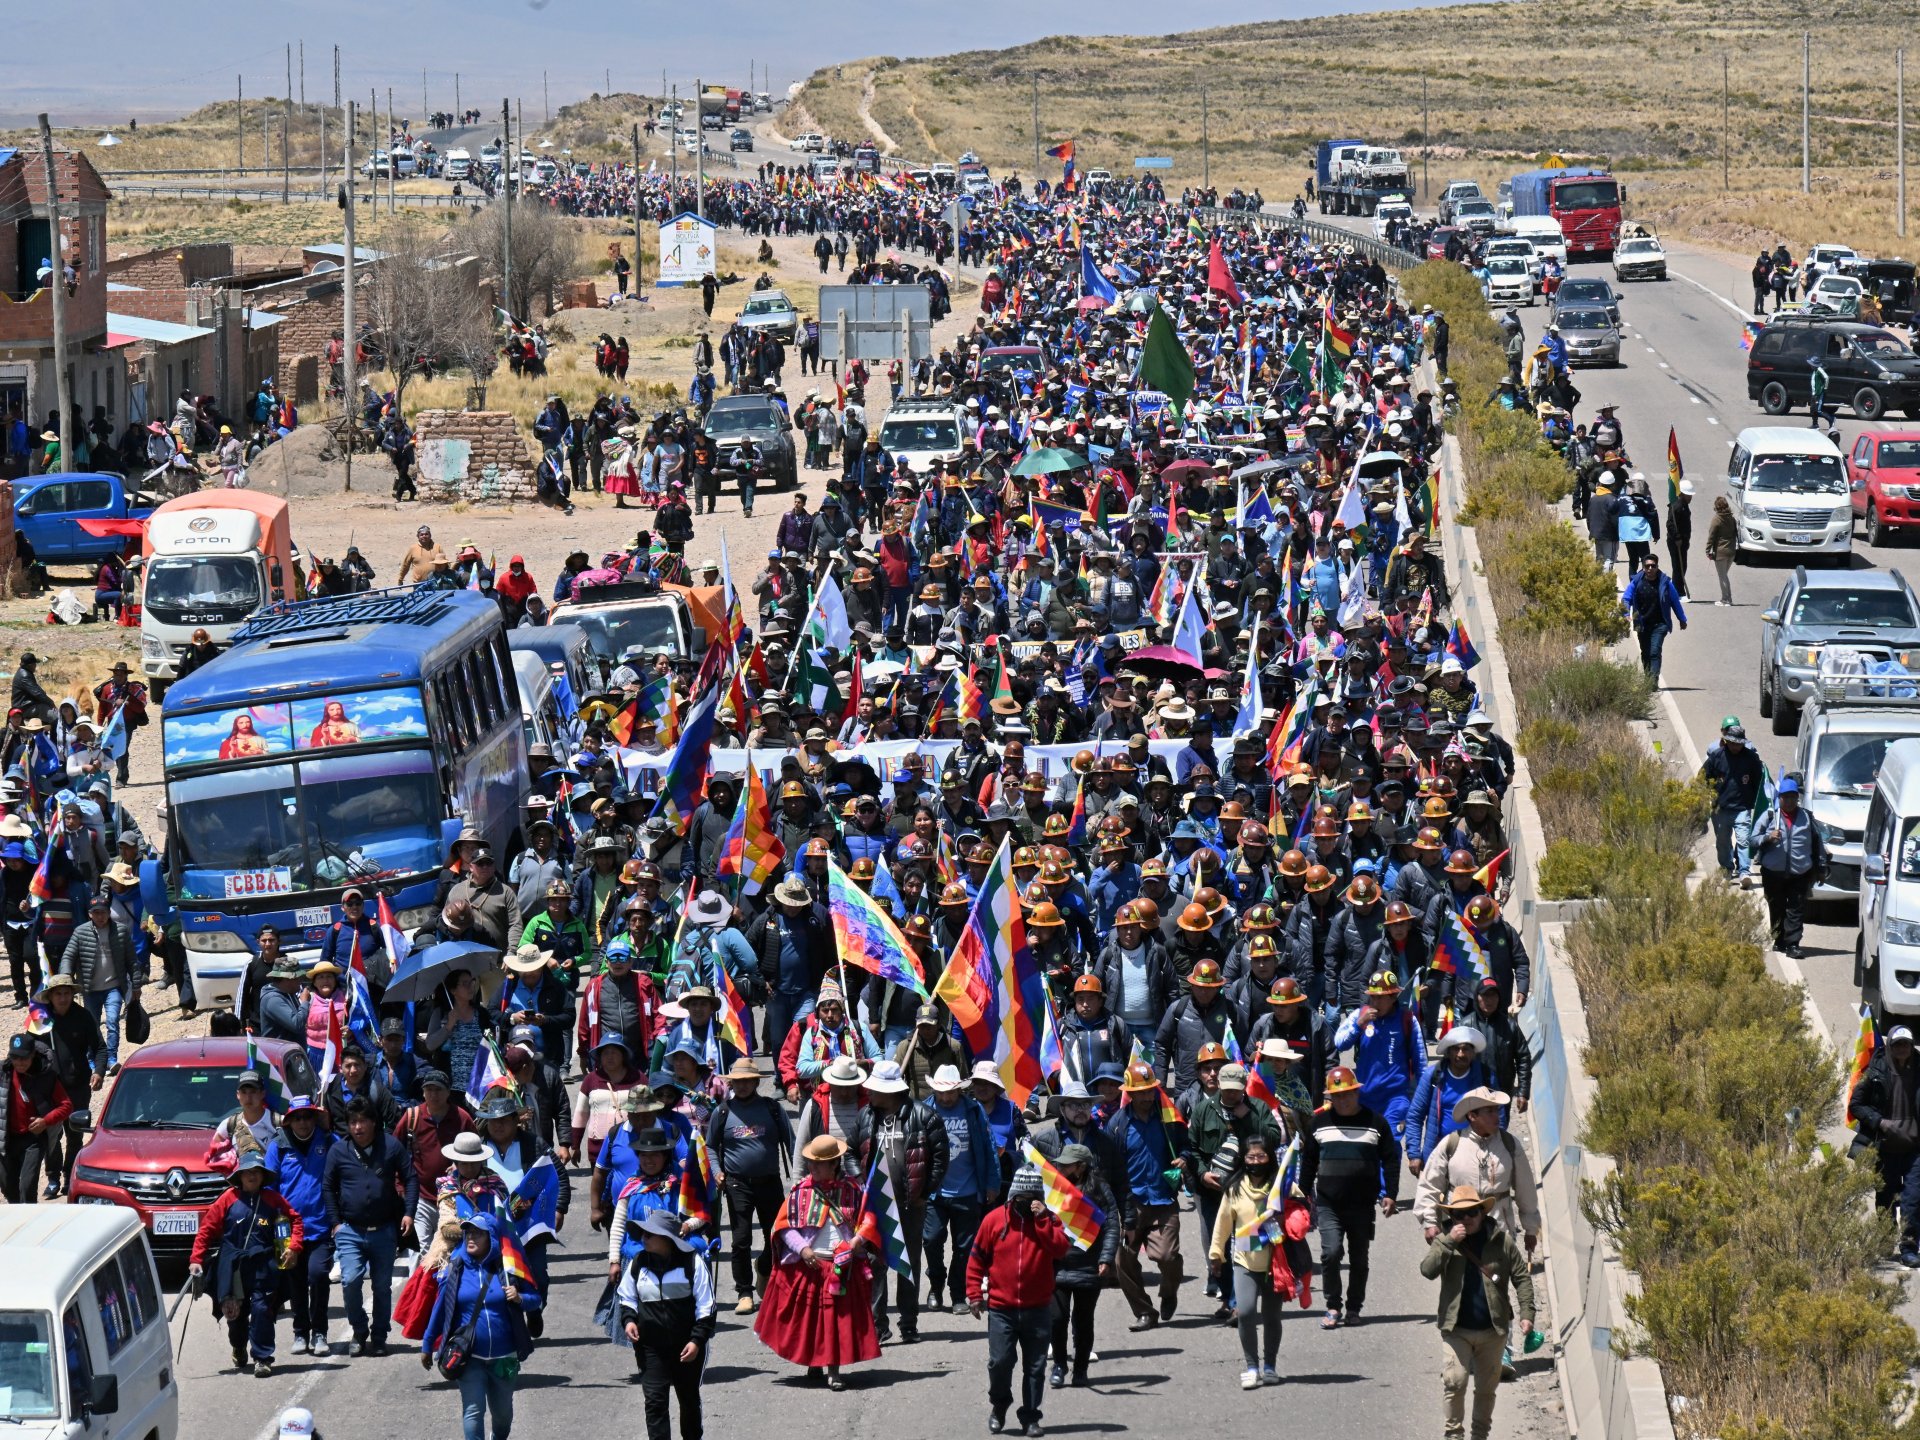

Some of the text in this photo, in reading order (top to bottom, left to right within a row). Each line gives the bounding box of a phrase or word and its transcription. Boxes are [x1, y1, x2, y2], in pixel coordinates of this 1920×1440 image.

[174, 536, 231, 545] FOTON
[180, 613, 223, 622] FOTON
[232, 871, 288, 895] CBBA.
[156, 1219, 197, 1233] 6277EHU
